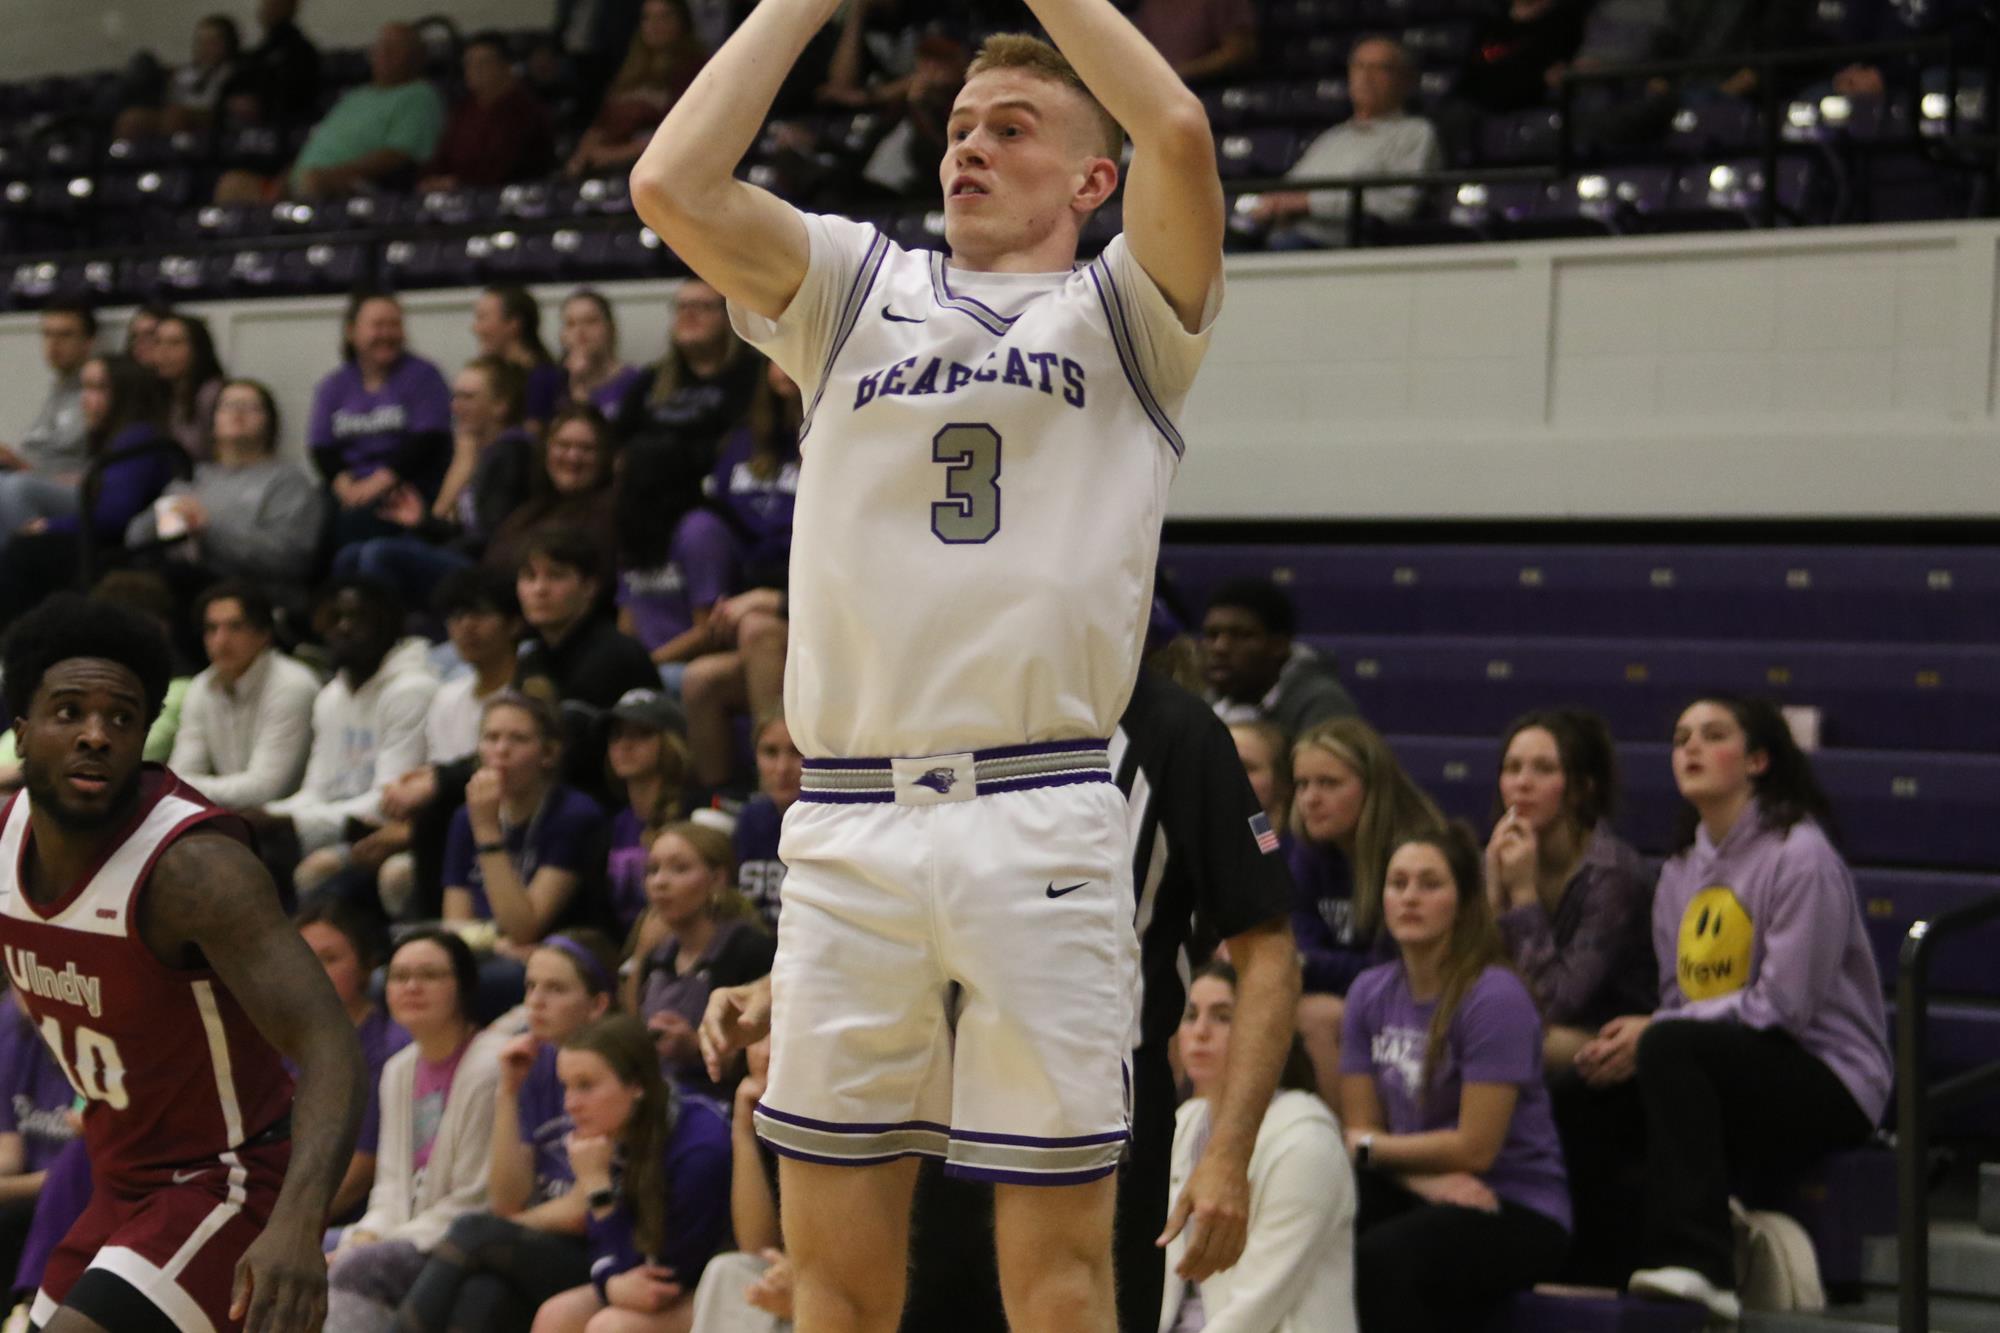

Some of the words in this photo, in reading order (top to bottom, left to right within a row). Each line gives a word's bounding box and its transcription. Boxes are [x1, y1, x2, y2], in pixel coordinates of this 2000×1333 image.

[853, 347, 1086, 411] BEARCATS
[931, 423, 1002, 544] 3
[4, 944, 103, 1018] UIndy
[40, 1015, 129, 1110] 10
